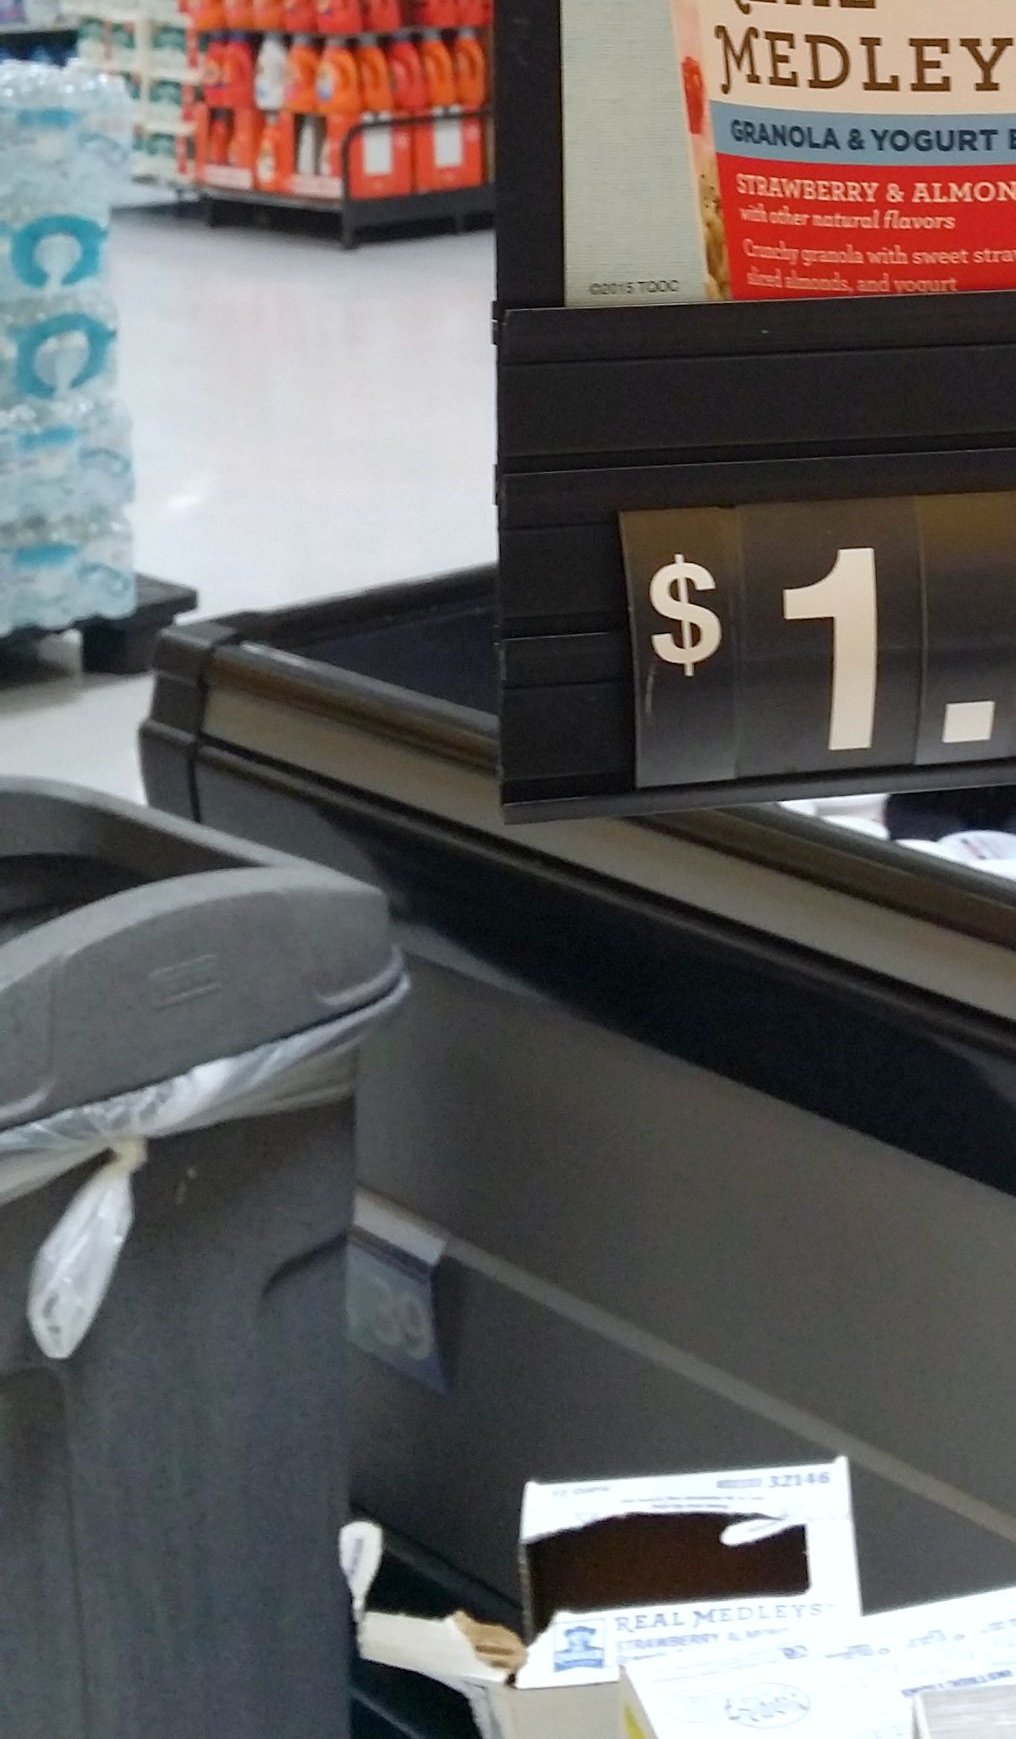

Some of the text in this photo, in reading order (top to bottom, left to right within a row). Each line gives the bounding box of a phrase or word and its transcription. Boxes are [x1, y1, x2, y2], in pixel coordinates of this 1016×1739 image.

[730, 119, 840, 151] GRANOLA
[848, 128, 866, 151] &
[871, 128, 998, 152] YOGURT
[735, 172, 878, 203] STRAWBERRY
[886, 182, 904, 203] &
[769, 206, 810, 226] other
[812, 210, 880, 229] natural
[882, 209, 955, 230] flavors
[742, 237, 799, 266] Crunchy
[801, 243, 865, 268] granola
[866, 244, 908, 265] with
[912, 249, 969, 266] sweet
[857, 273, 890, 292] and
[894, 276, 958, 296] yogurt
[614, 1604, 823, 1633] REAL MEDLEYS
